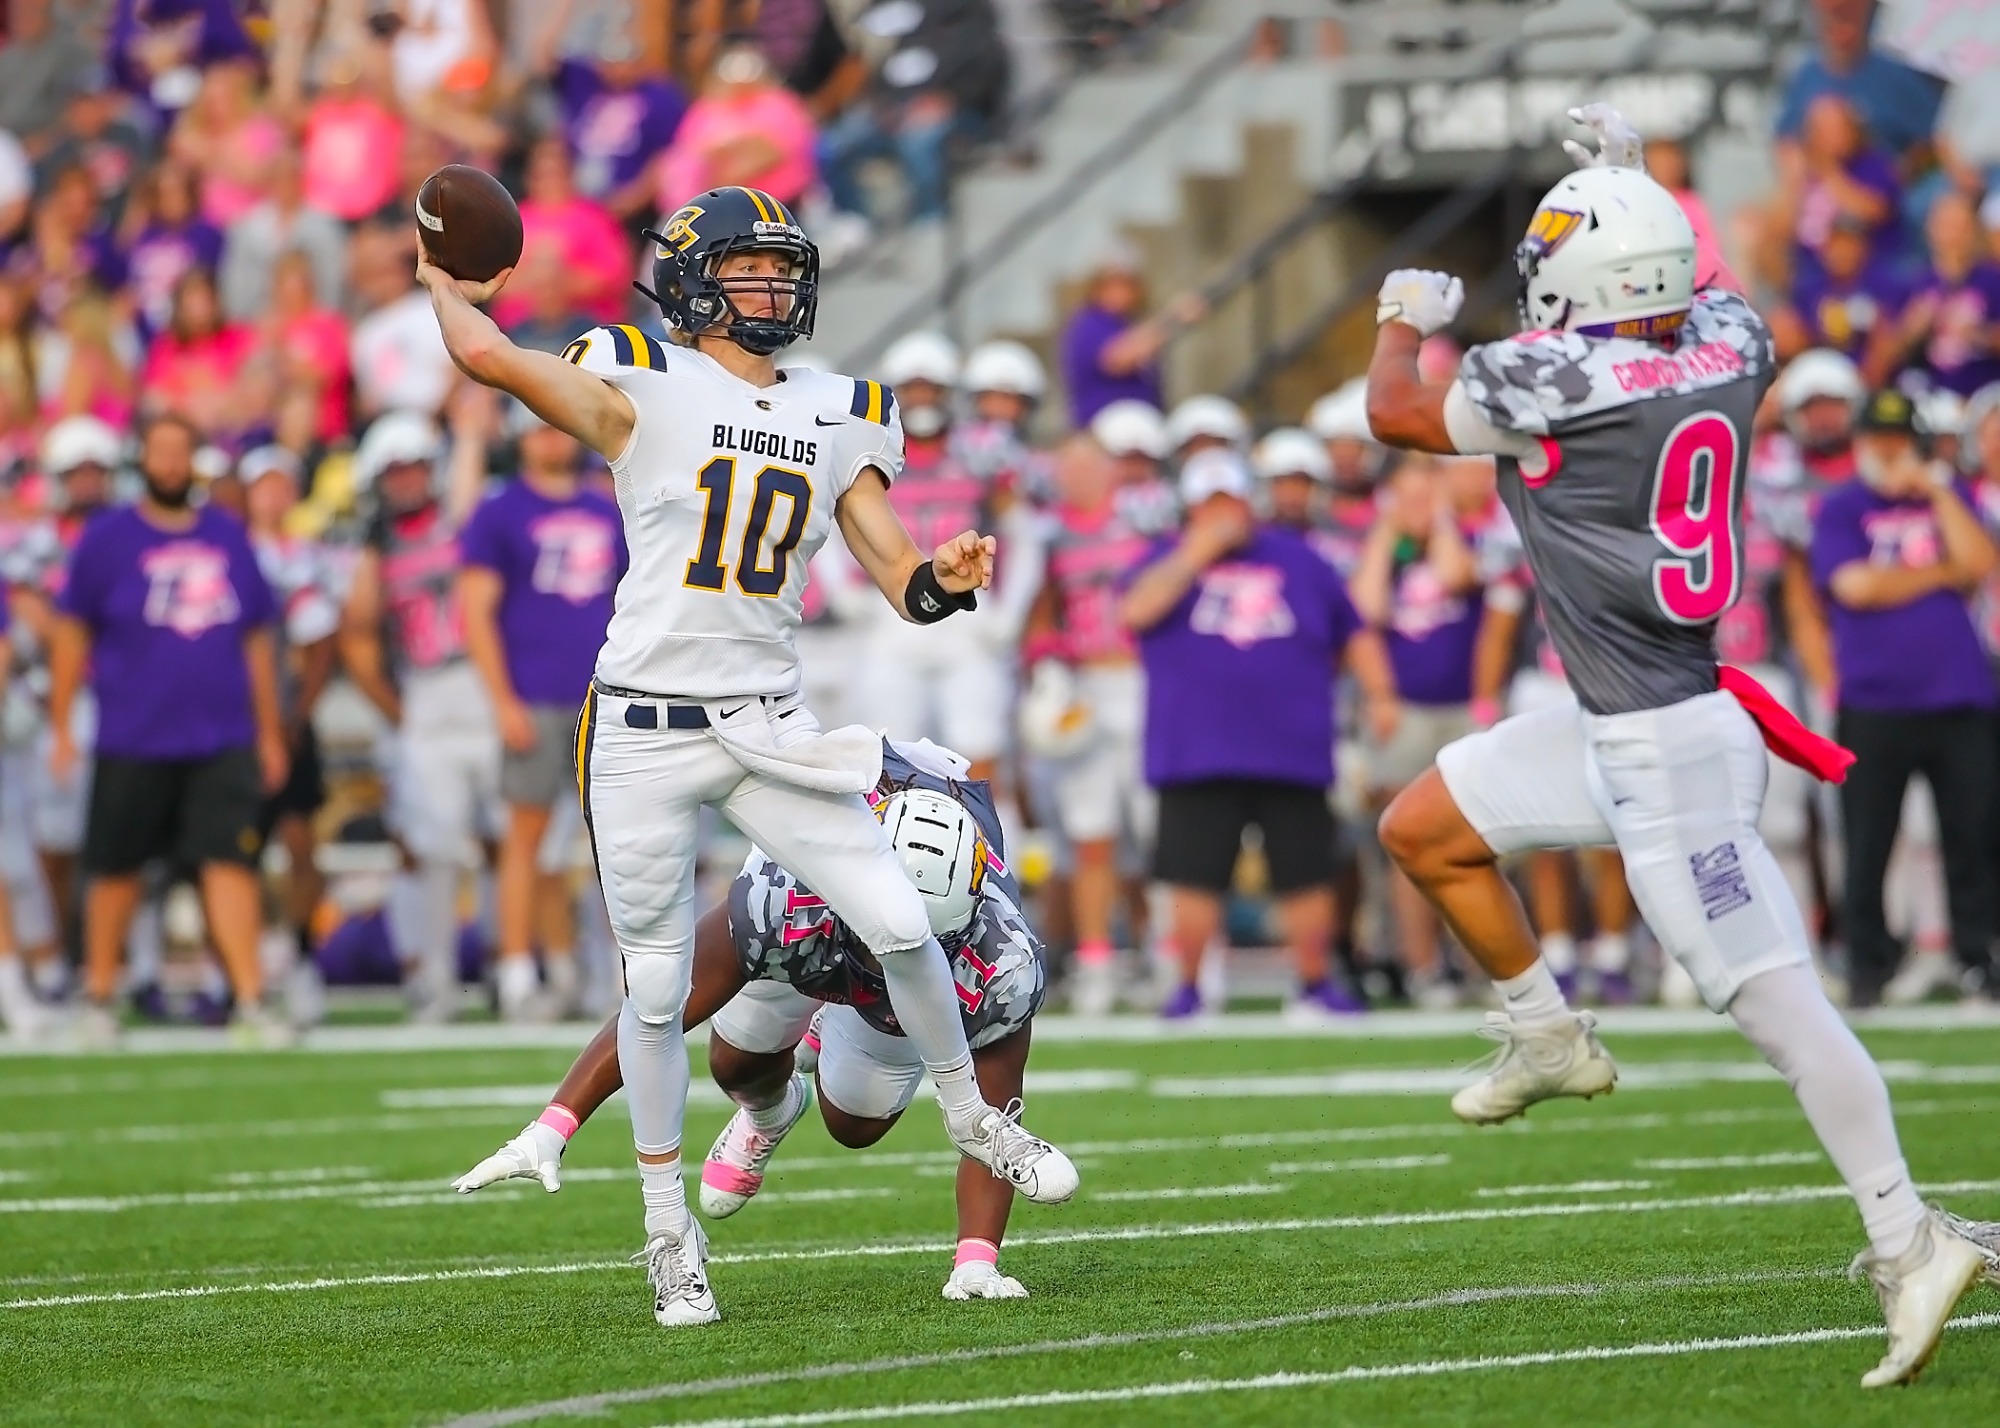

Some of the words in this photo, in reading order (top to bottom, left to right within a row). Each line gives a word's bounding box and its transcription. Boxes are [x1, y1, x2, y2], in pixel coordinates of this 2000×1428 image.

[711, 424, 818, 467] BLUGOLDS
[682, 455, 815, 599] 10
[1648, 410, 1740, 627] 9
